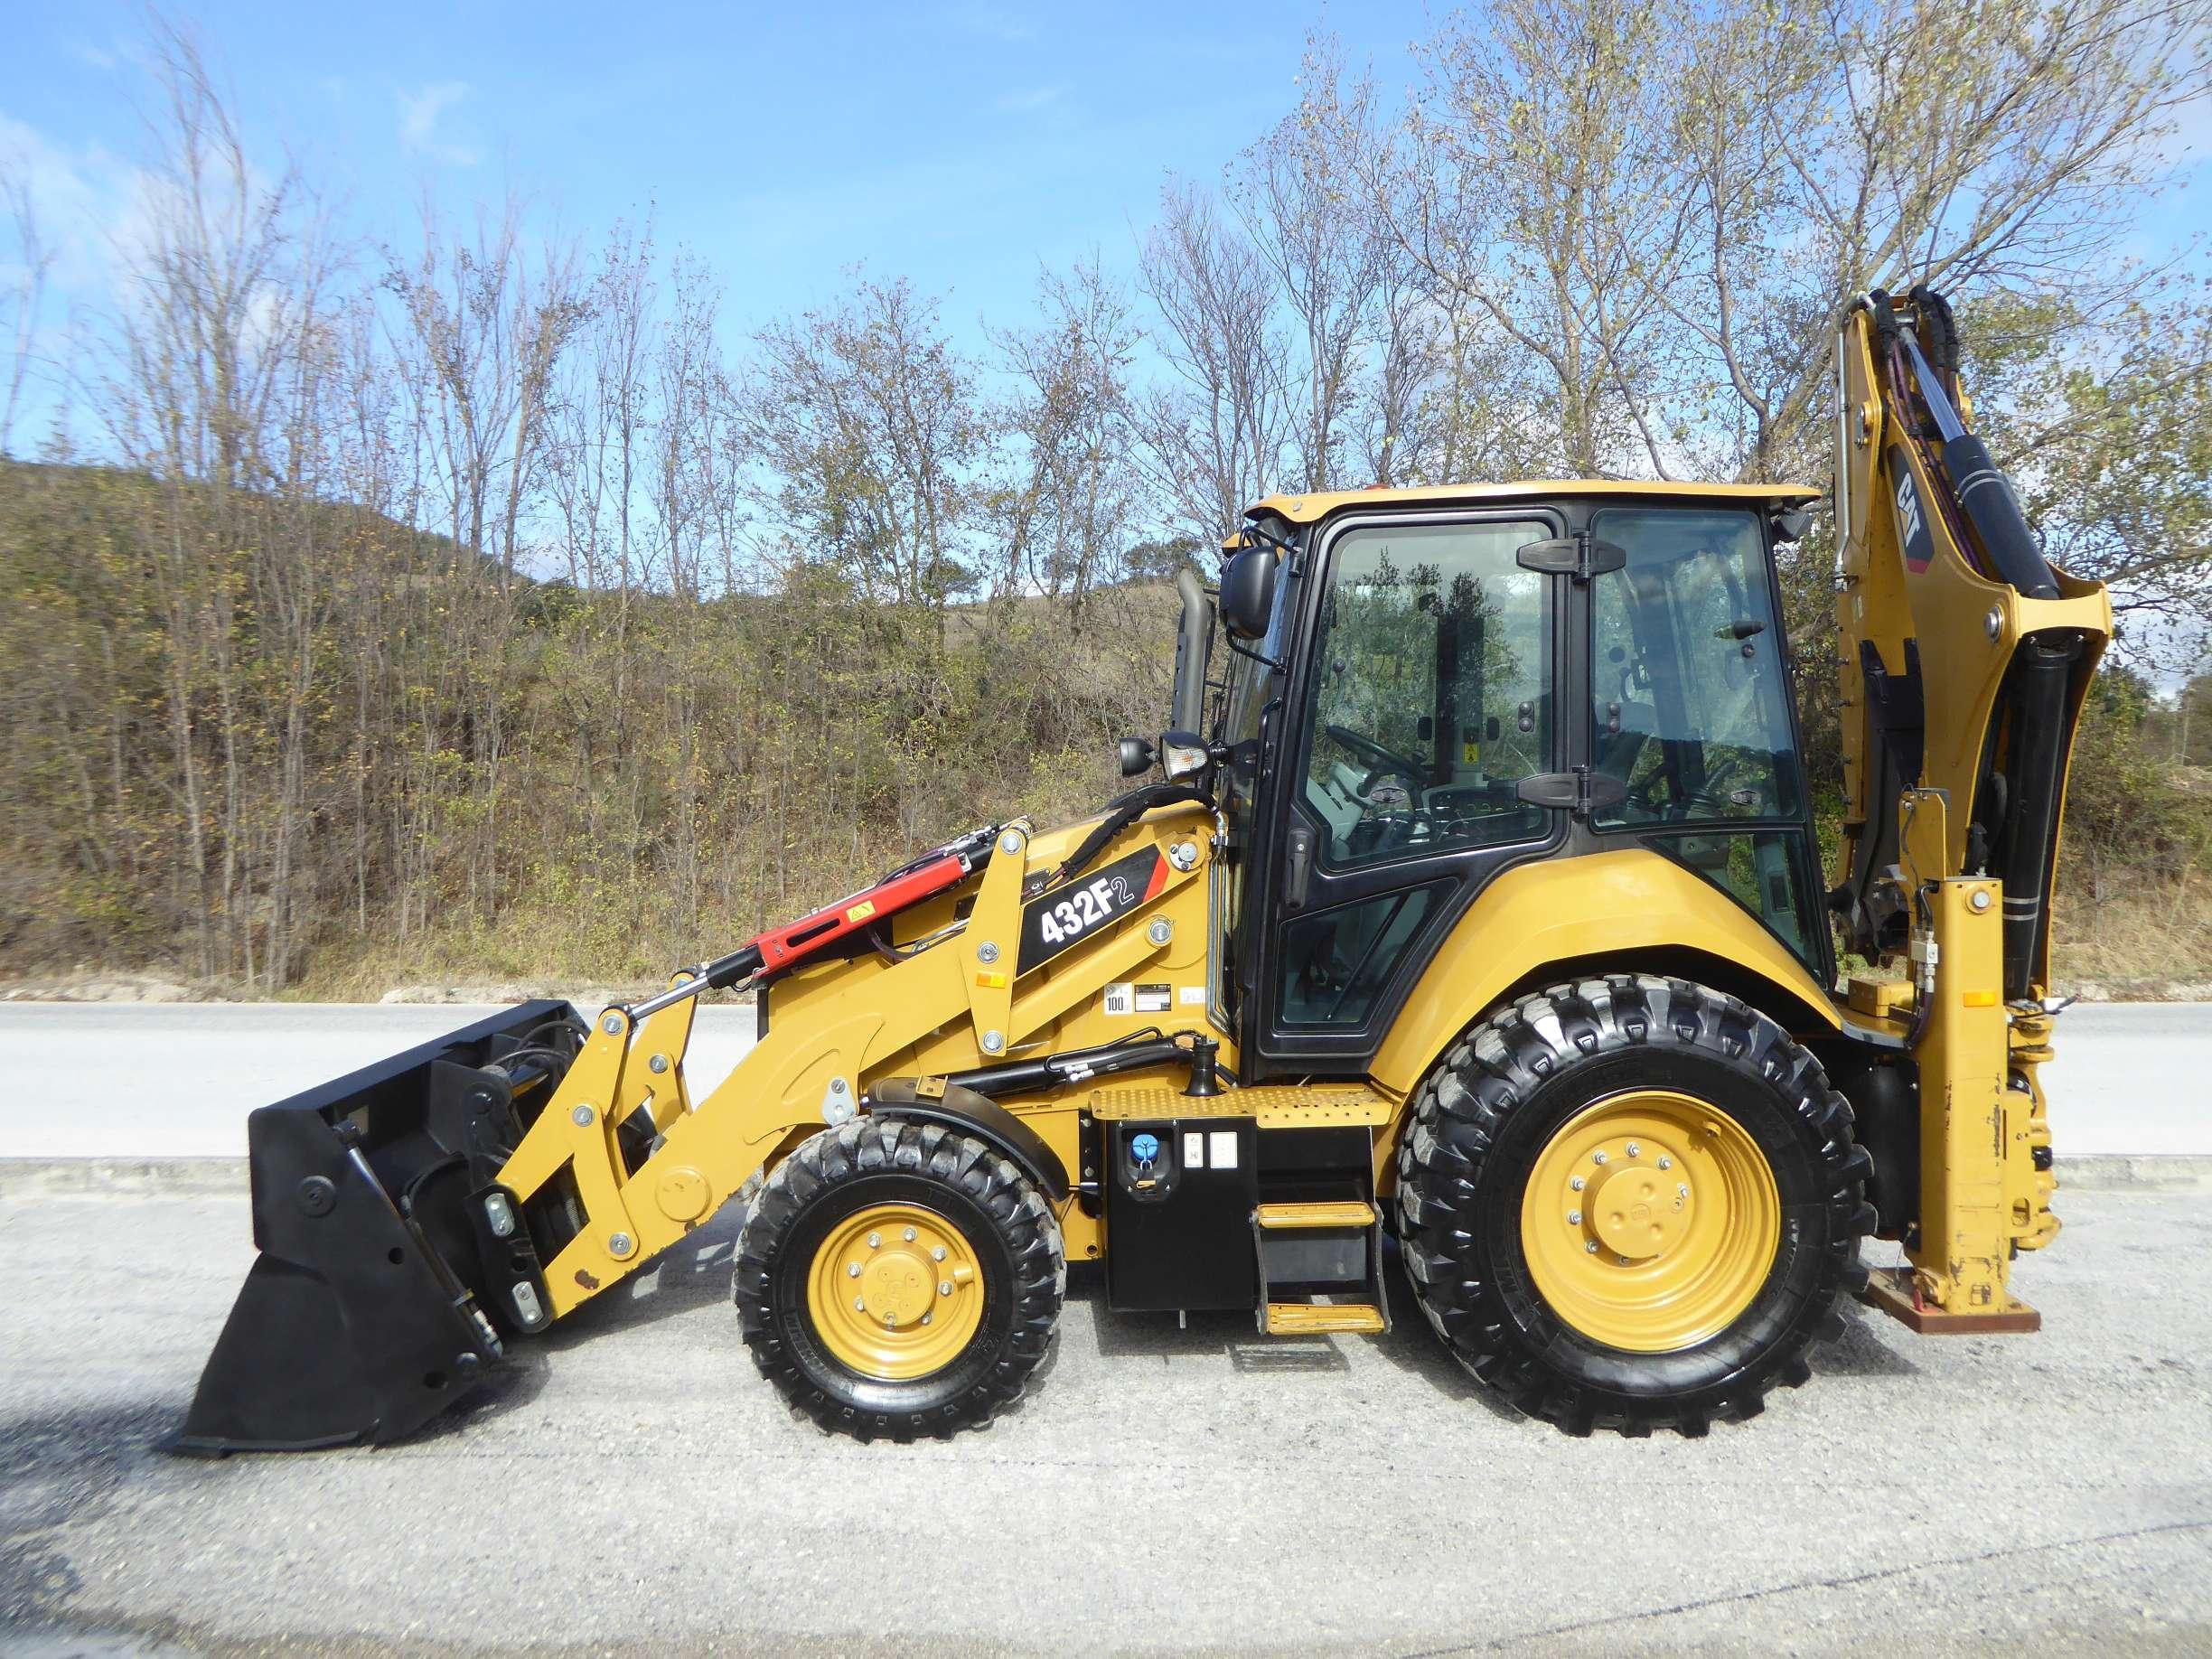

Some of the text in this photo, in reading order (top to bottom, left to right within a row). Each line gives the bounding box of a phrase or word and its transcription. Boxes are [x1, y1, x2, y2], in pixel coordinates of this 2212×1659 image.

[1898, 473, 1920, 548] CAT
[1041, 876, 1135, 945] 432F2
[1108, 997, 1124, 1011] 100
